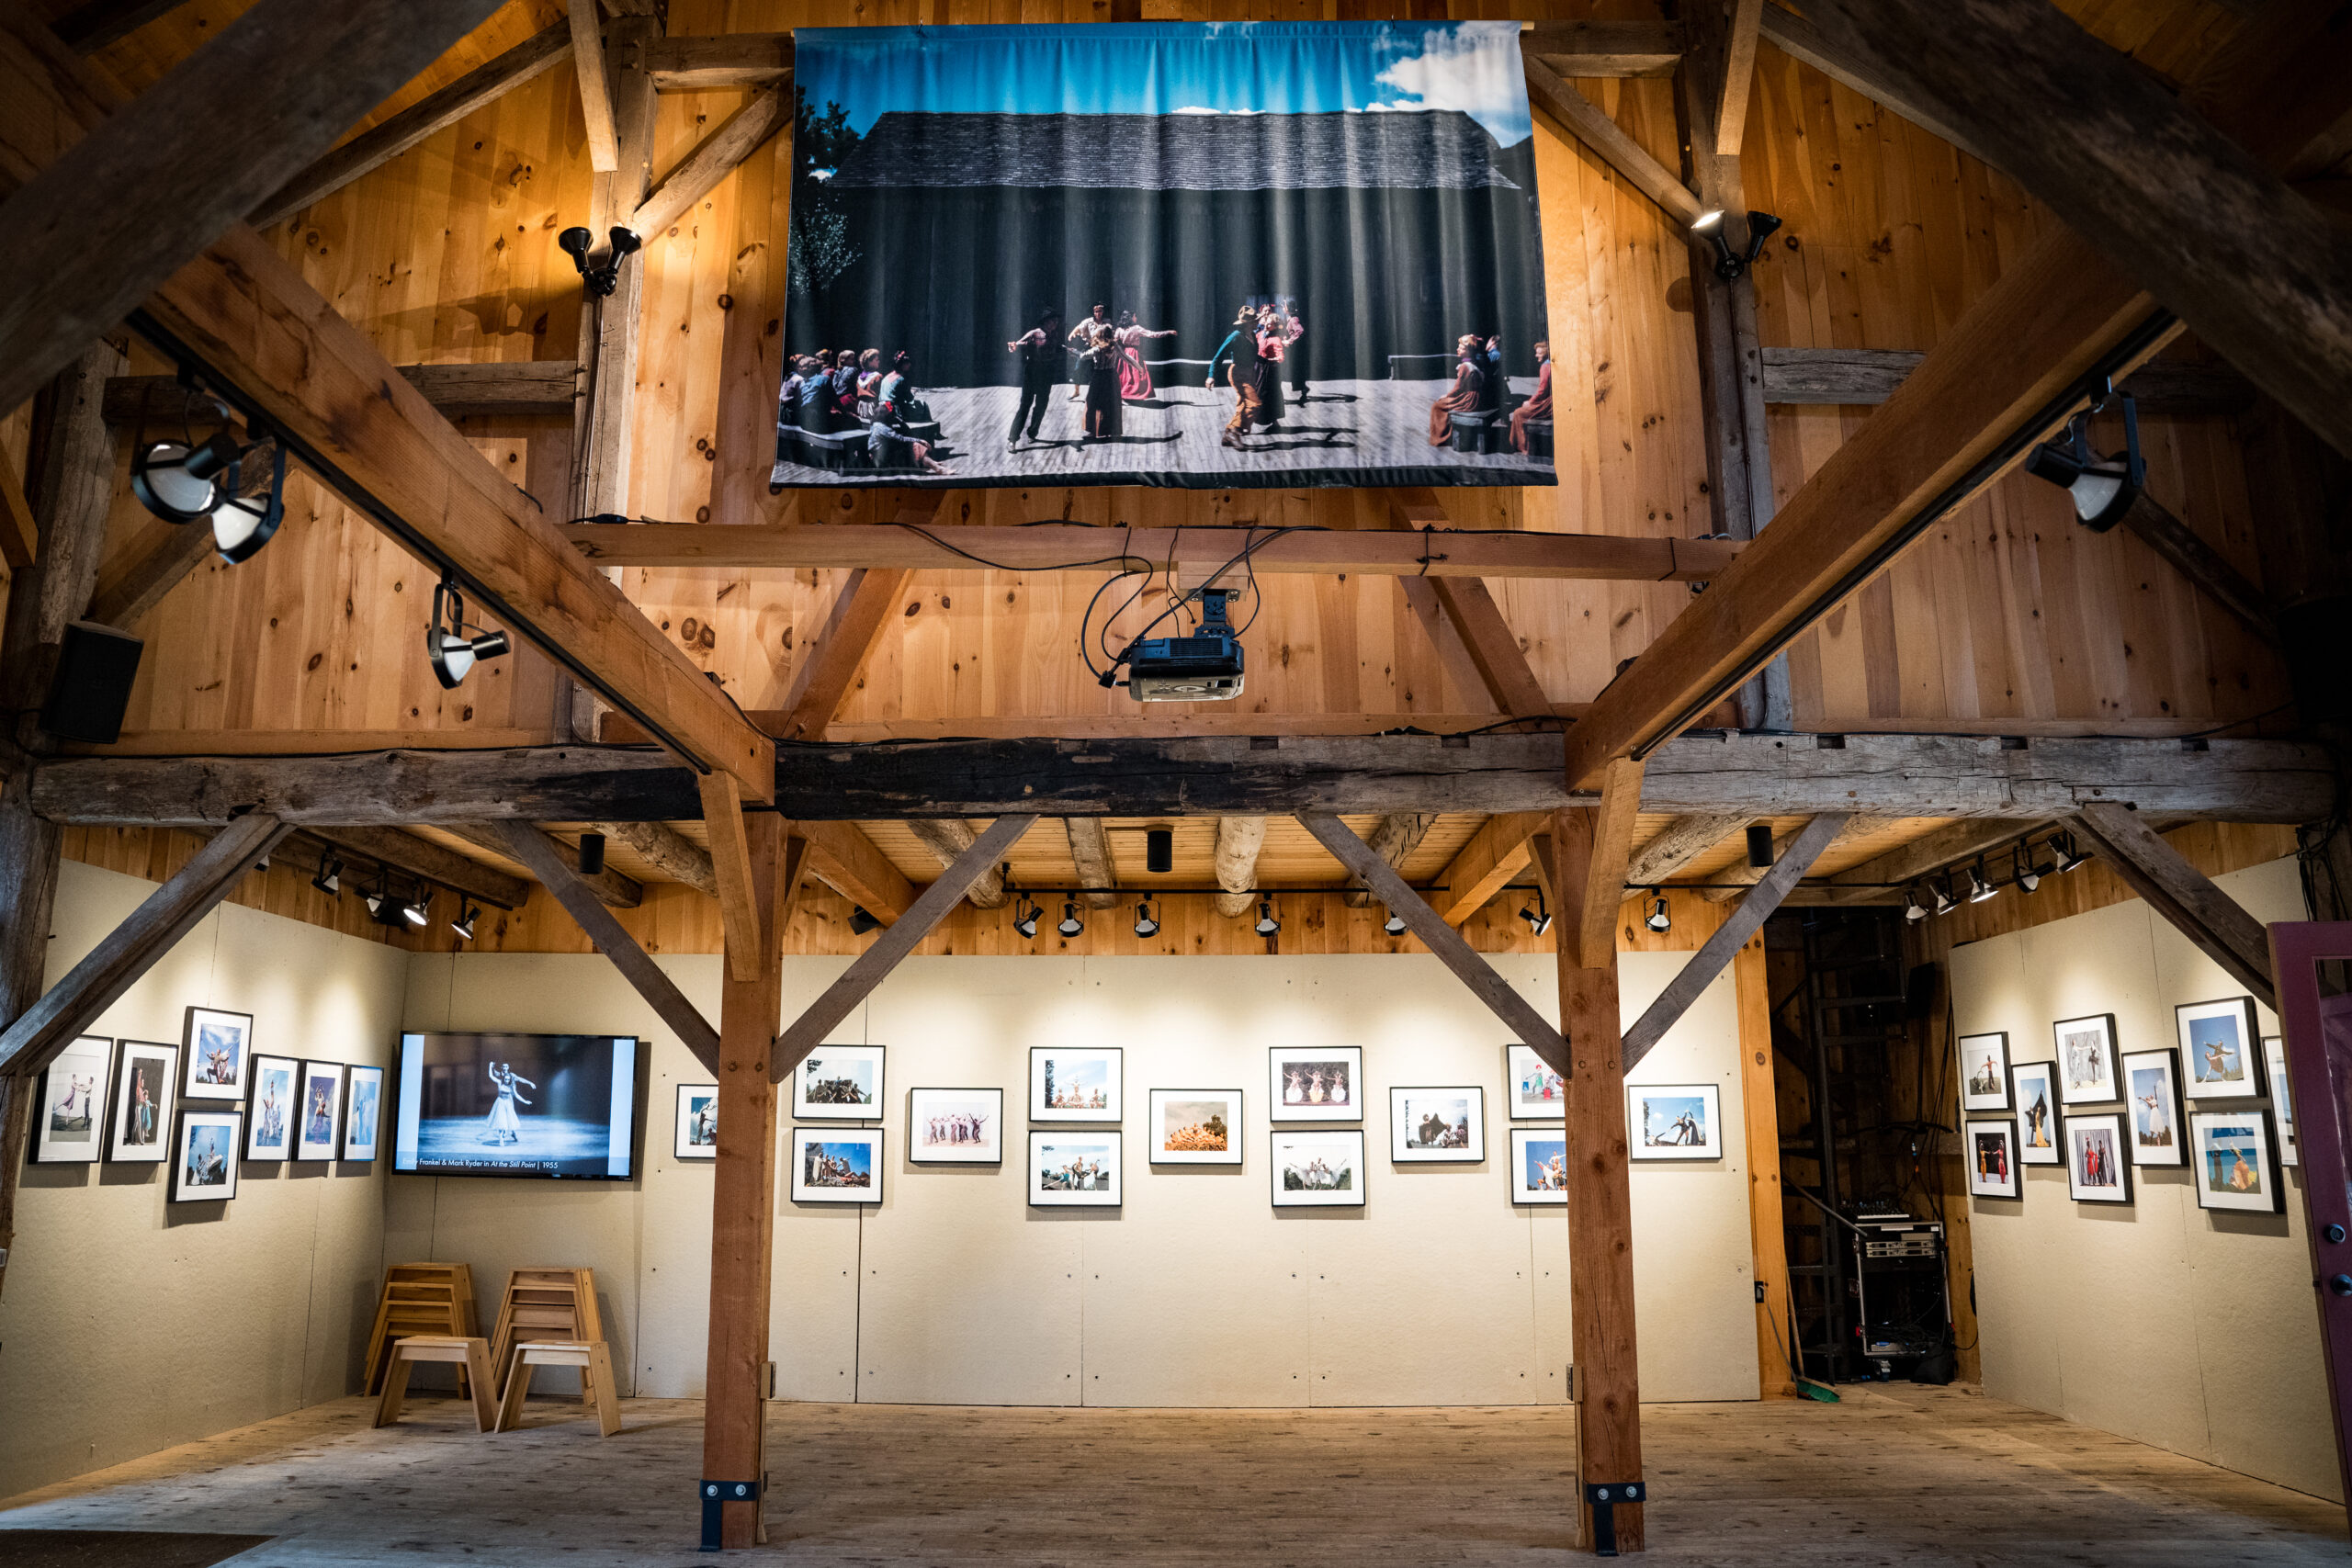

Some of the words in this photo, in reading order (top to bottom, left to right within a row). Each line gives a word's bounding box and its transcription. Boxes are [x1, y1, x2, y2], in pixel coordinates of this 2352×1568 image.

[419, 1157, 440, 1166] Frankel
[465, 1159, 482, 1168] Ryder
[509, 1160, 520, 1168] Still
[542, 1161, 559, 1169] 1955
